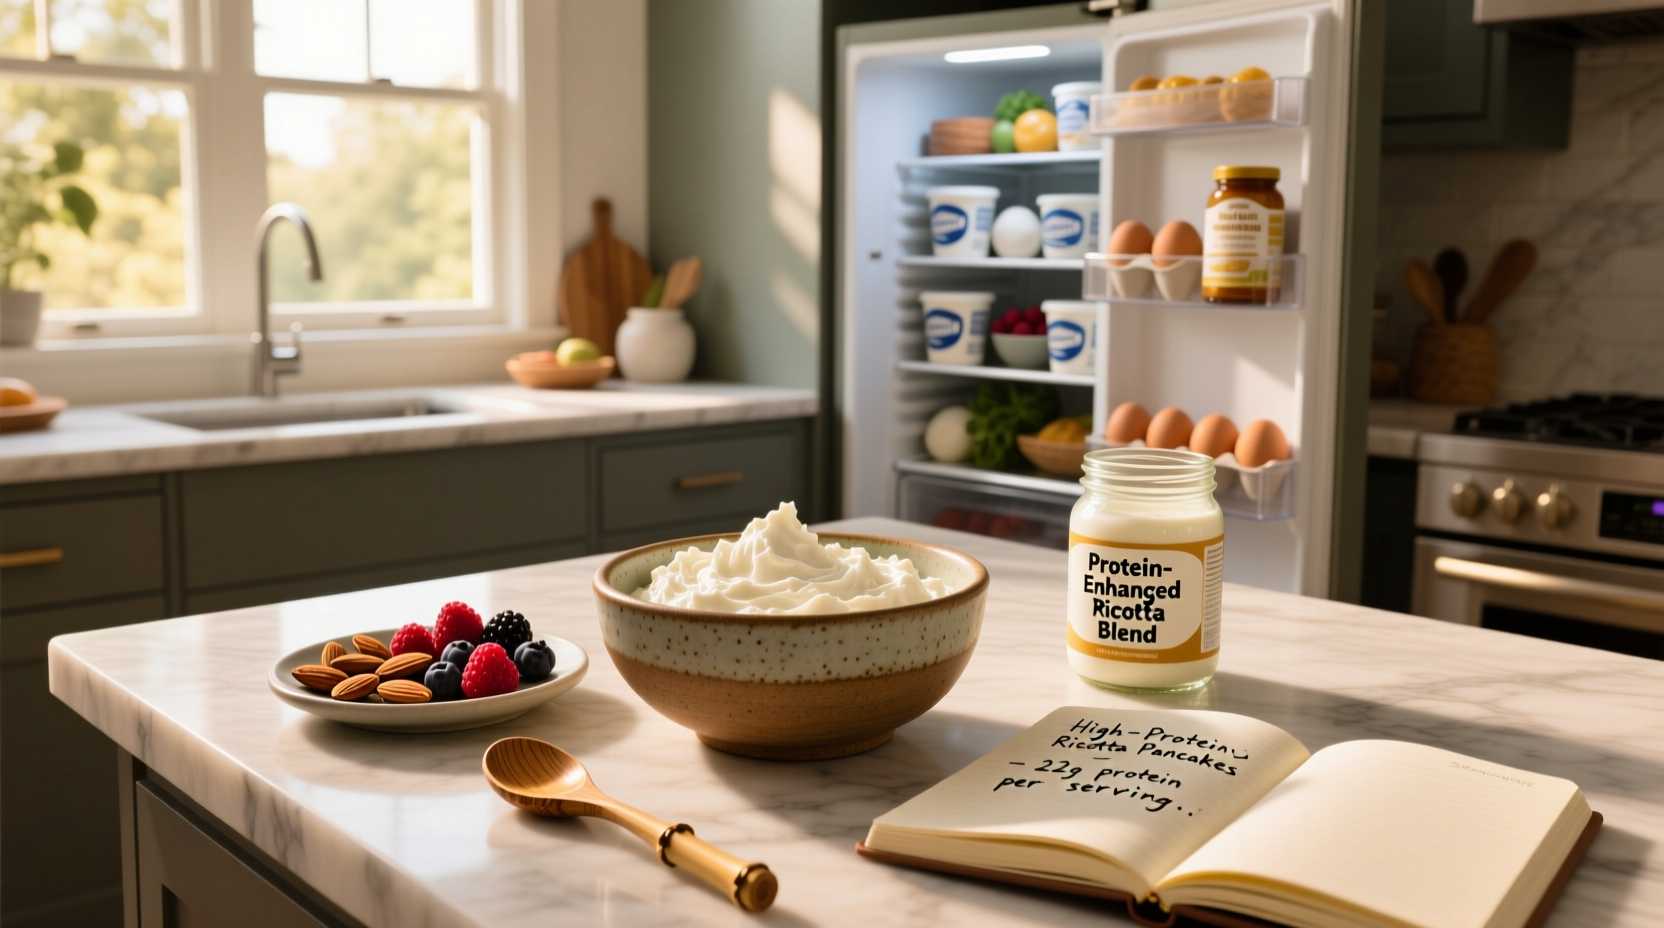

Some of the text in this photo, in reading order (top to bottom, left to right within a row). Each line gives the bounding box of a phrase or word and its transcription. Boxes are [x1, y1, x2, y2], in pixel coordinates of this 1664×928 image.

[1088, 552, 1173, 578] Protein-
[1084, 573, 1181, 607] Enhanced
[1092, 597, 1165, 622] Ricotta
[1098, 620, 1157, 644] Blend
[1051, 735, 1238, 776] Ricotta Pancakes
[993, 777, 1045, 792] per
[1034, 759, 1082, 779] 22g
[1093, 767, 1182, 789] protein
